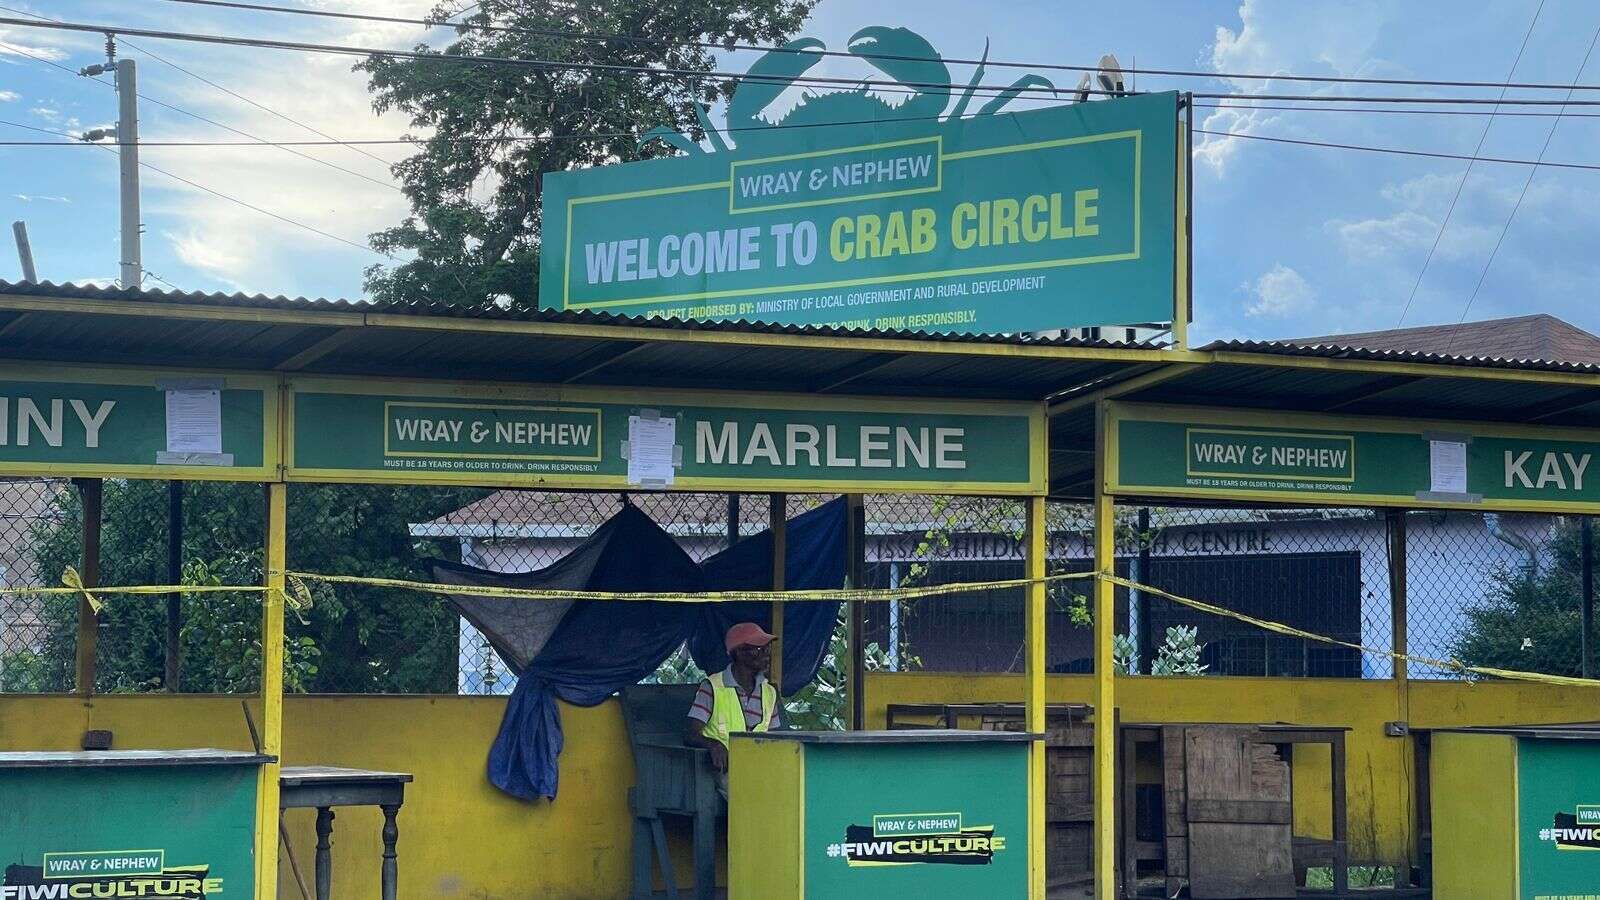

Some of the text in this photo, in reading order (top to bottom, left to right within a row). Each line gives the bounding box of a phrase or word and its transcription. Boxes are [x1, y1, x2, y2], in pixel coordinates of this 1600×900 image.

[740, 155, 932, 197] WRAY & NEPHEW
[585, 188, 1099, 284] WELCOME TO CRAB CIRCLE
[688, 304, 736, 318] ENDORSED
[739, 302, 755, 314] BY:
[756, 299, 799, 313] MINISTRY
[801, 297, 813, 310] OF
[815, 294, 845, 308] LOCAL
[847, 288, 912, 306] GOVERNMENT
[914, 286, 934, 300] AND
[937, 283, 969, 298] RURAL
[972, 276, 1046, 295] DEVELOPMENT
[875, 316, 906, 330] DRINK
[908, 310, 977, 328] RESPONSIBLY.
[395, 418, 592, 446] WRAY & NEPHEW
[696, 421, 966, 469] MARLENE
[1195, 443, 1346, 468] WRAY & NEPHEW
[384, 460, 403, 468] MUST
[429, 461, 451, 469] YEARS
[528, 463, 550, 471] DRINK
[551, 464, 598, 472] RESPONSIBLY
[1504, 450, 1592, 490] KAY
[1315, 483, 1352, 491] RESPONSIBLY
[1182, 528, 1272, 553] CENTRE
[878, 819, 957, 831] WRAY & NEPHEW
[826, 837, 1006, 857] #FIWICULTURE
[50, 857, 158, 872] WRAY & NEPHEW
